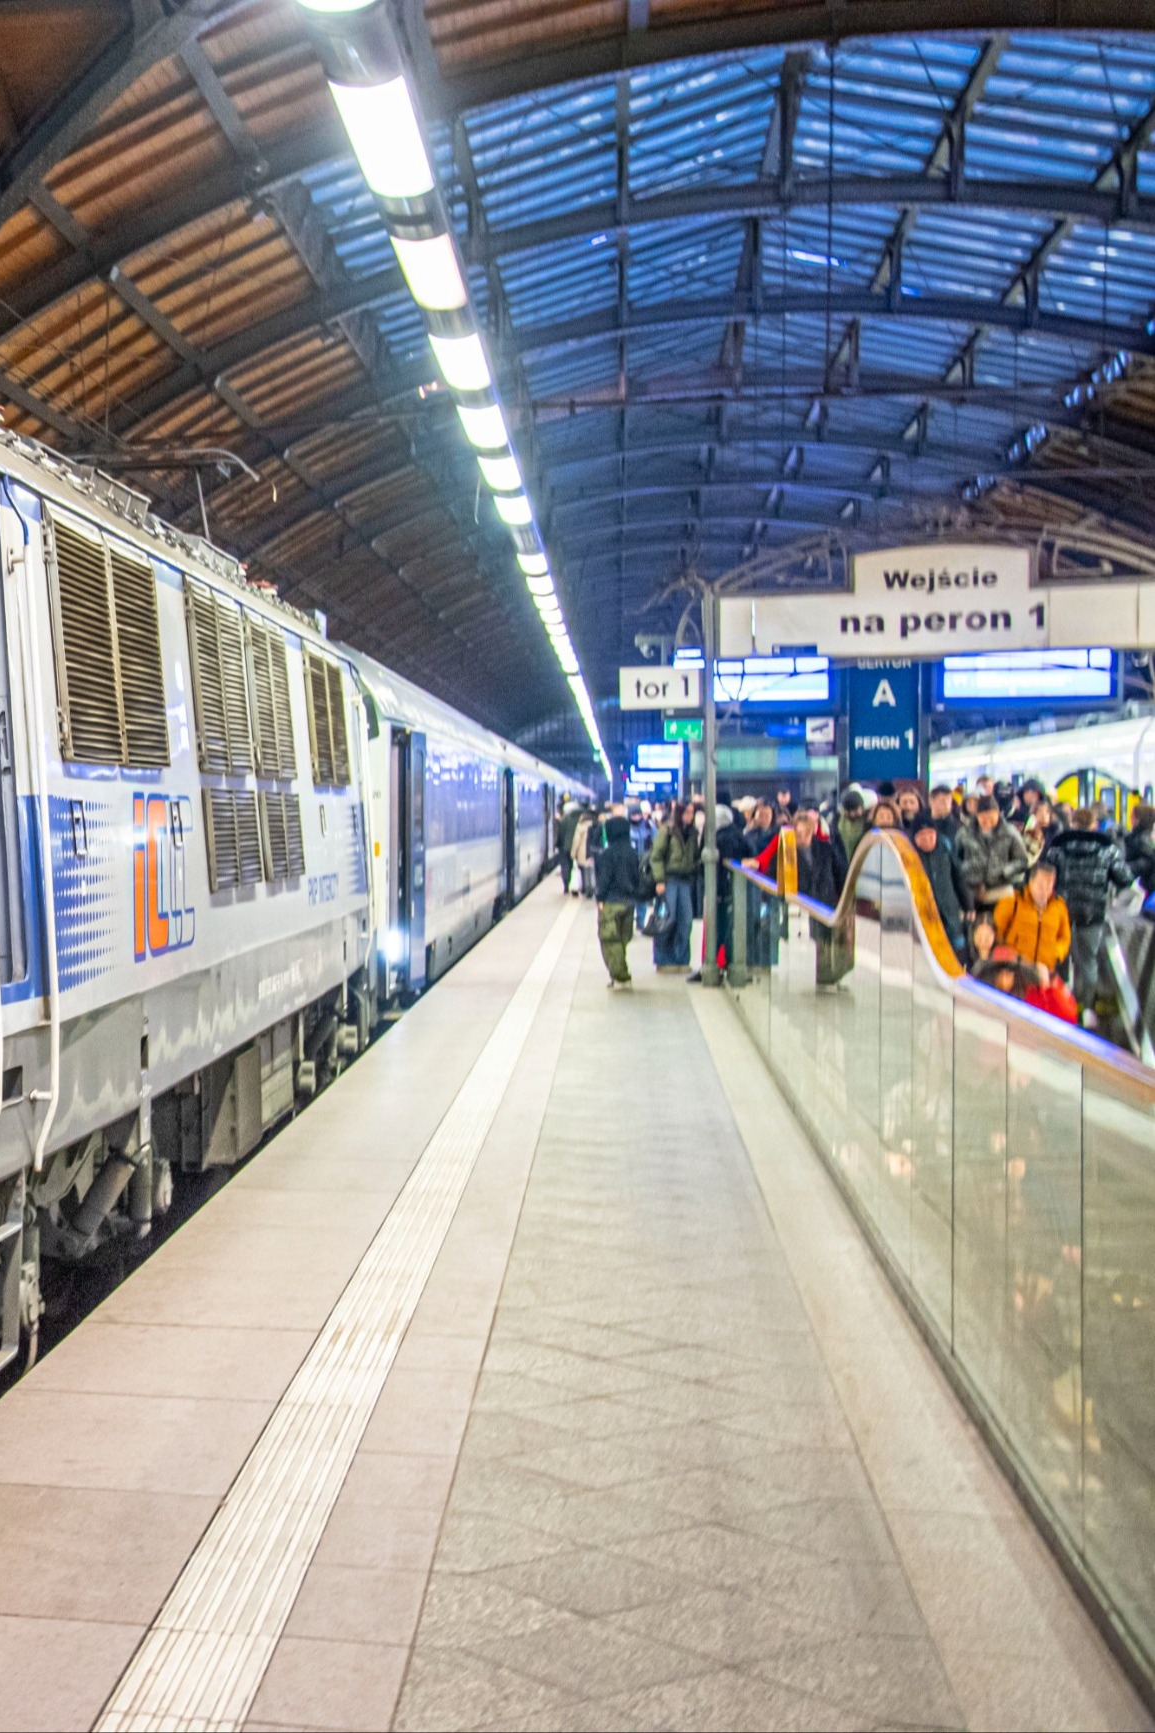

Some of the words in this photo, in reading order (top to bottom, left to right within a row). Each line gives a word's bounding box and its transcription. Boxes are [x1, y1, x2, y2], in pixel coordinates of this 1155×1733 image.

[883, 567, 998, 594] Wejście
[840, 613, 885, 634] na
[900, 609, 1013, 639] peron
[1029, 602, 1045, 630] 1
[635, 679, 669, 699] tor
[681, 676, 690, 697] 1
[872, 678, 897, 708] A
[854, 735, 900, 751] PERON
[904, 727, 914, 751] 1
